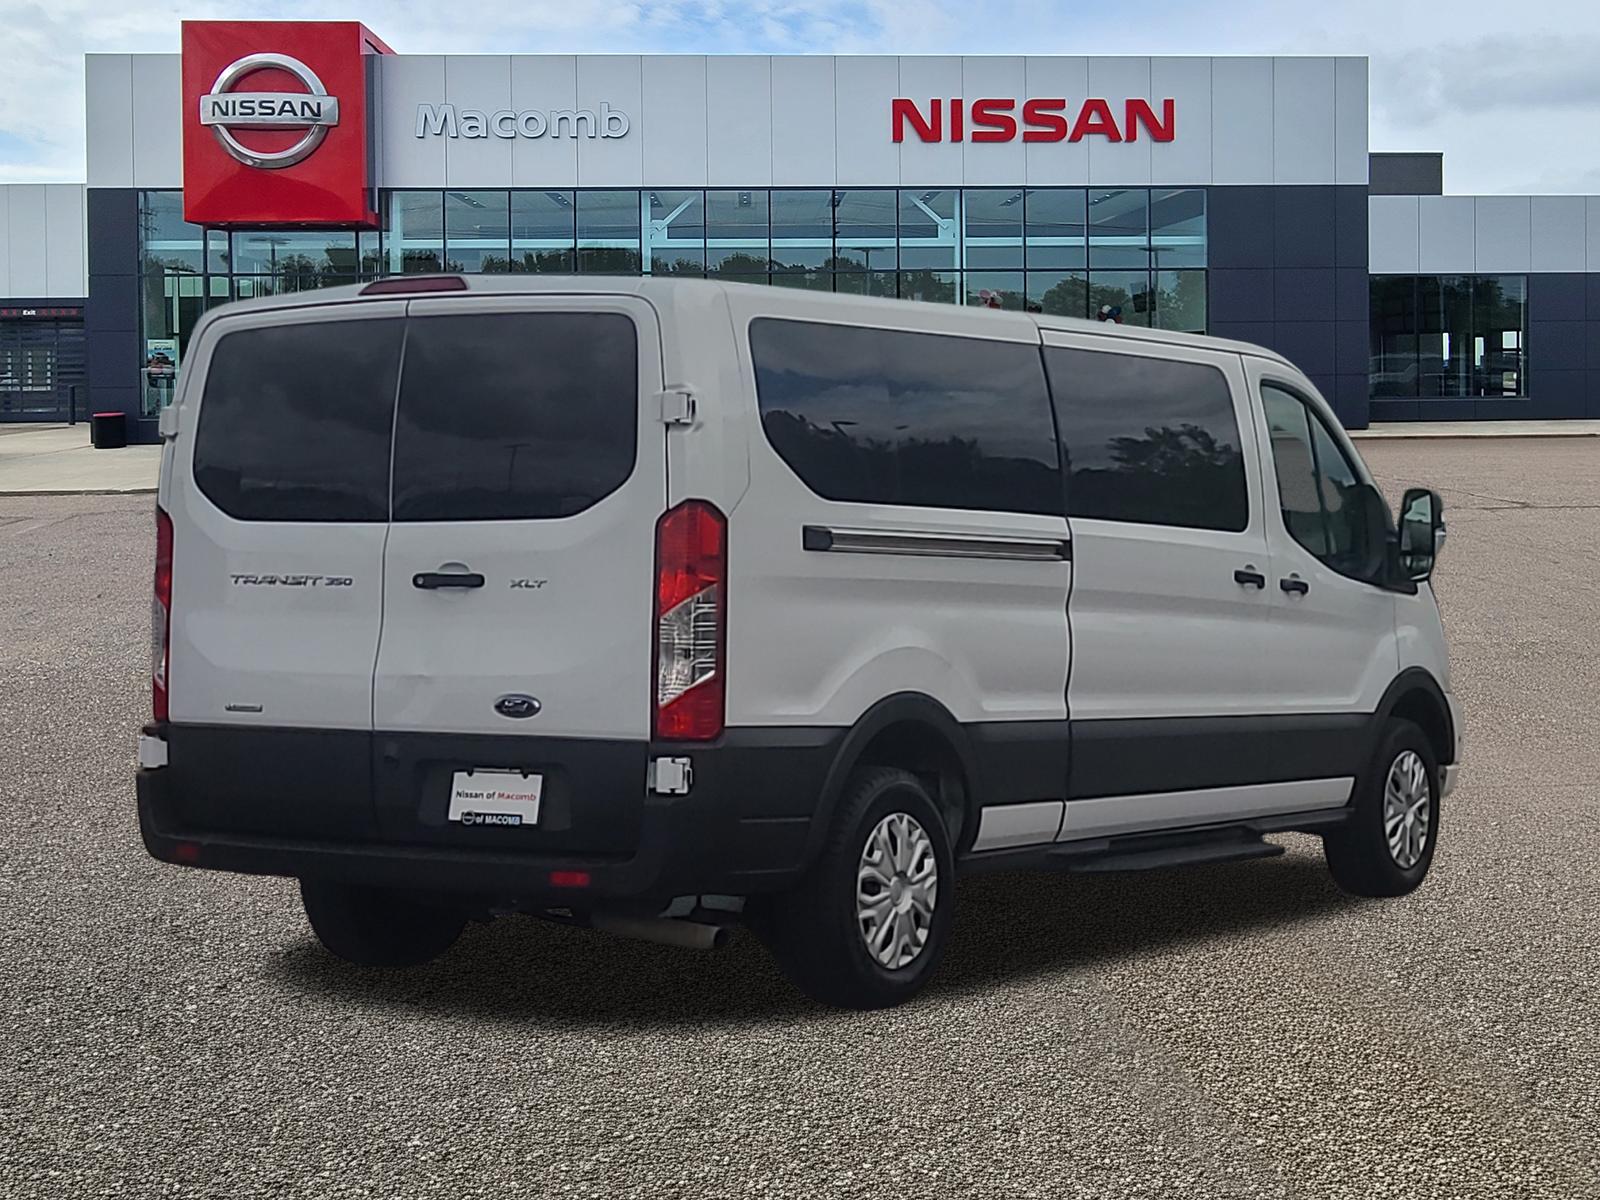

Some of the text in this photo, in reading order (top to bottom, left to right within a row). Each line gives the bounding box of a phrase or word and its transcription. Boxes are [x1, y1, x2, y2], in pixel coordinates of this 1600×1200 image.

[212, 100, 322, 118] NISSAN
[415, 102, 630, 138] Macomb
[892, 98, 1175, 143] NISSAN
[230, 574, 353, 587] TRANSIT 350
[510, 579, 548, 589] XLT
[456, 790, 537, 802] Nissan of Macomb
[475, 815, 521, 825] of MACOMB
